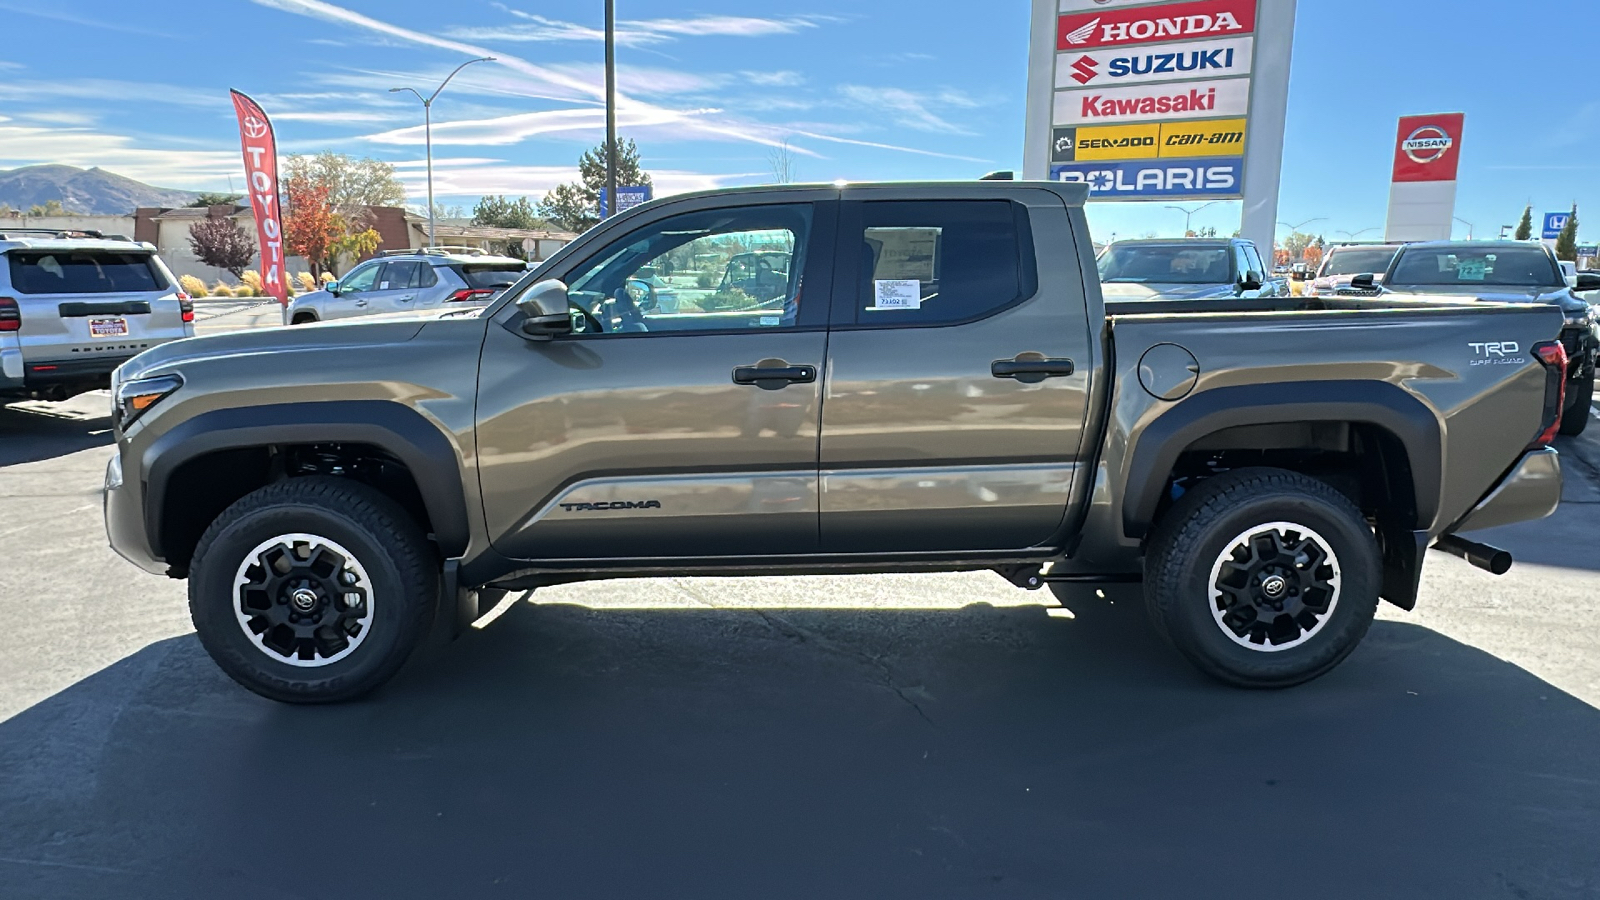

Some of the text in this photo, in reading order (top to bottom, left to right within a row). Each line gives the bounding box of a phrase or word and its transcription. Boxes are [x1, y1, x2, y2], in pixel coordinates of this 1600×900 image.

[1100, 11, 1242, 42] HONDA
[1108, 48, 1234, 77] SUZUKI
[1081, 87, 1216, 118] Kawasaki
[1406, 139, 1447, 148] NISSAN
[247, 147, 280, 284] TOYOTA
[1467, 341, 1519, 358] TRD
[559, 500, 661, 512] TACOMA
